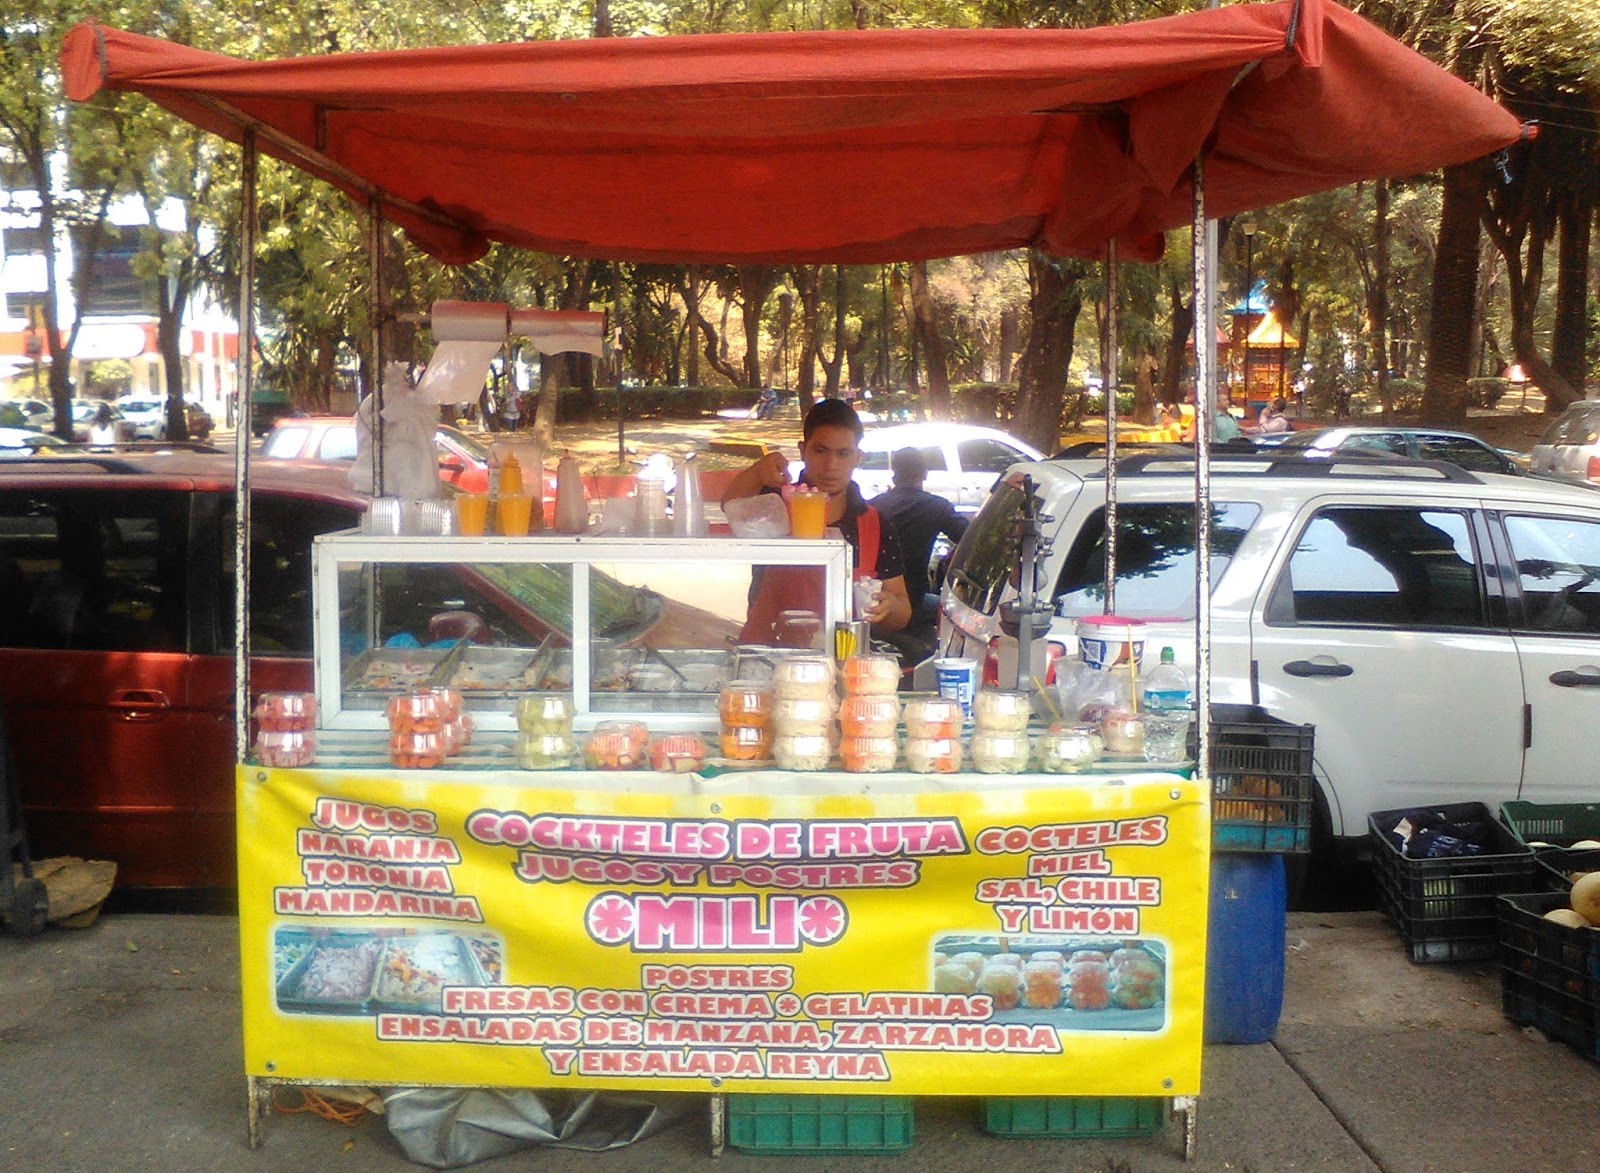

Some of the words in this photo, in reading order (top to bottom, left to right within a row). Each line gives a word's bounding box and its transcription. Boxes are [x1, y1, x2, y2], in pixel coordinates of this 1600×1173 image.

[312, 799, 437, 833] JUGOS
[299, 829, 460, 863] NARANJA
[468, 813, 729, 858] COCKTELES
[737, 822, 801, 859] DE
[809, 821, 965, 858] FRUTA
[976, 817, 1167, 853] COCTELES
[303, 859, 452, 892] TORONJA
[711, 861, 918, 887] POSTRES
[1029, 851, 1110, 876] MIEL
[276, 889, 483, 921] MANDARINA
[976, 879, 1056, 905] SAL,
[1058, 877, 1159, 905] CHILE
[995, 906, 1027, 932] Y
[642, 965, 793, 990] POSTRES
[443, 987, 574, 1014] FRESAS
[577, 988, 648, 1015] CON
[651, 992, 774, 1018] CREMA
[804, 993, 993, 1020] GELATINAS
[378, 1015, 581, 1044] ENSALADAS
[583, 1018, 642, 1045] DE:
[644, 1020, 832, 1050] MANZANA,
[834, 1022, 1063, 1052] ZARZAMORA
[543, 1050, 577, 1075] Y
[579, 1051, 765, 1077] ENSALADA
[767, 1053, 891, 1079] REYNA
